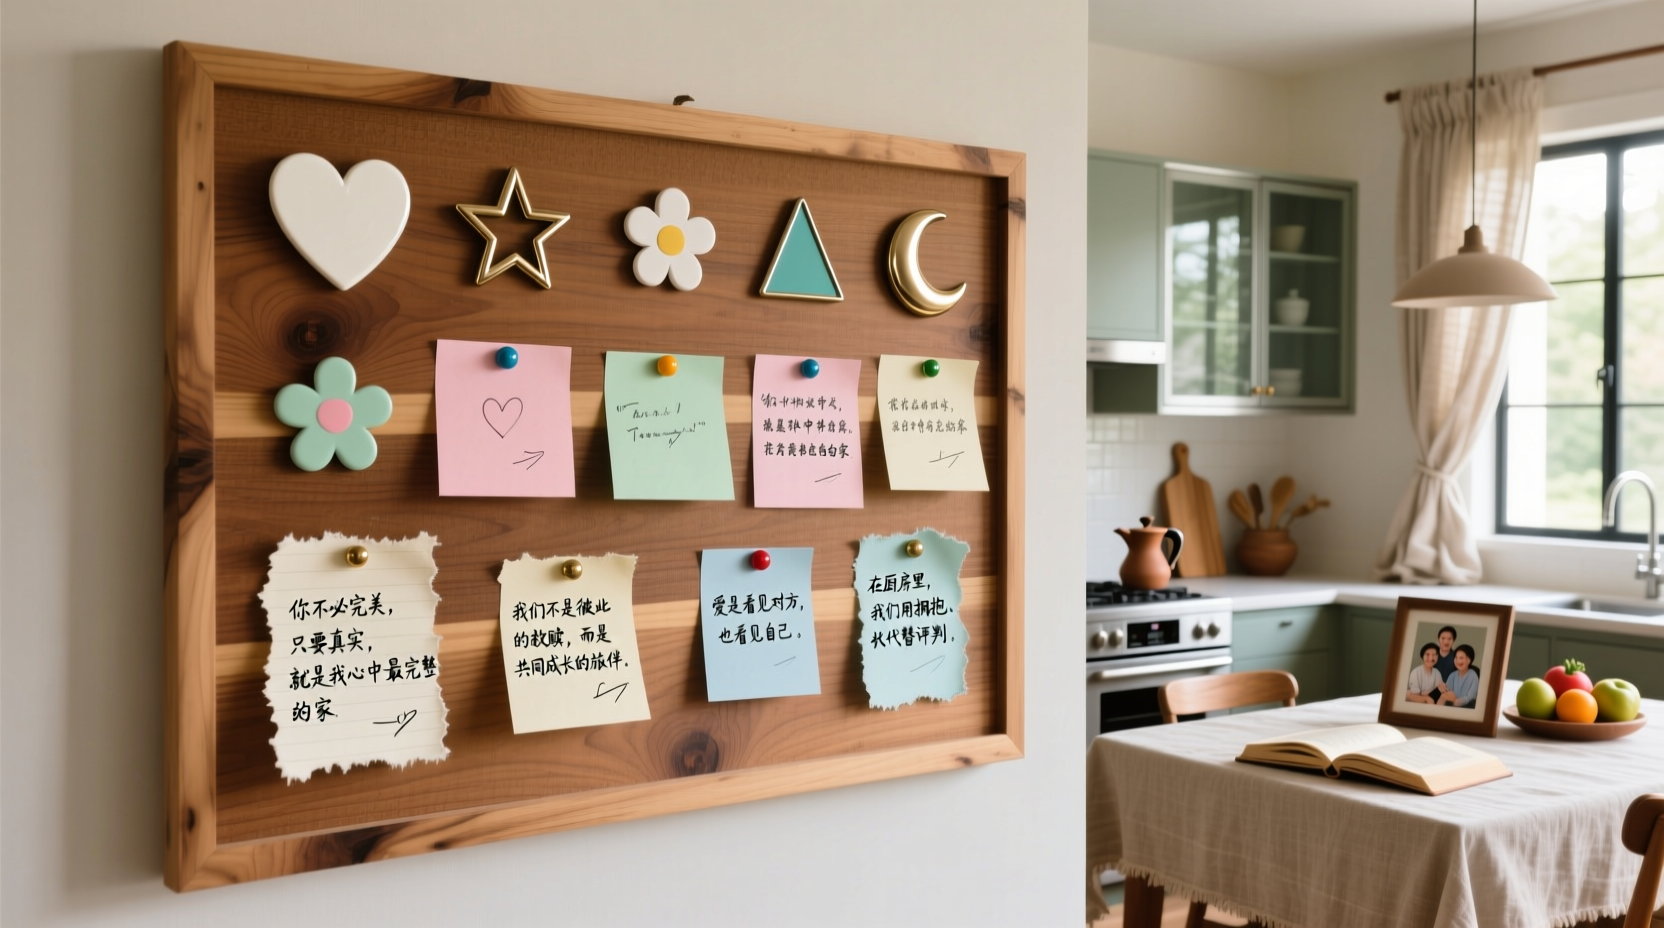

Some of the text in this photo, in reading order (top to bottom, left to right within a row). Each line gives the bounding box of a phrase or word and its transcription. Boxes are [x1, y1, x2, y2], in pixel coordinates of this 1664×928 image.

[289, 592, 394, 621] 你不必完美，
[512, 597, 612, 622] 我们不是彼此
[712, 591, 805, 616] 爱是看见对方，
[291, 628, 373, 655] 只要真实，
[718, 622, 802, 645] 也看见自己。
[289, 655, 438, 690] 就是我心中最完整
